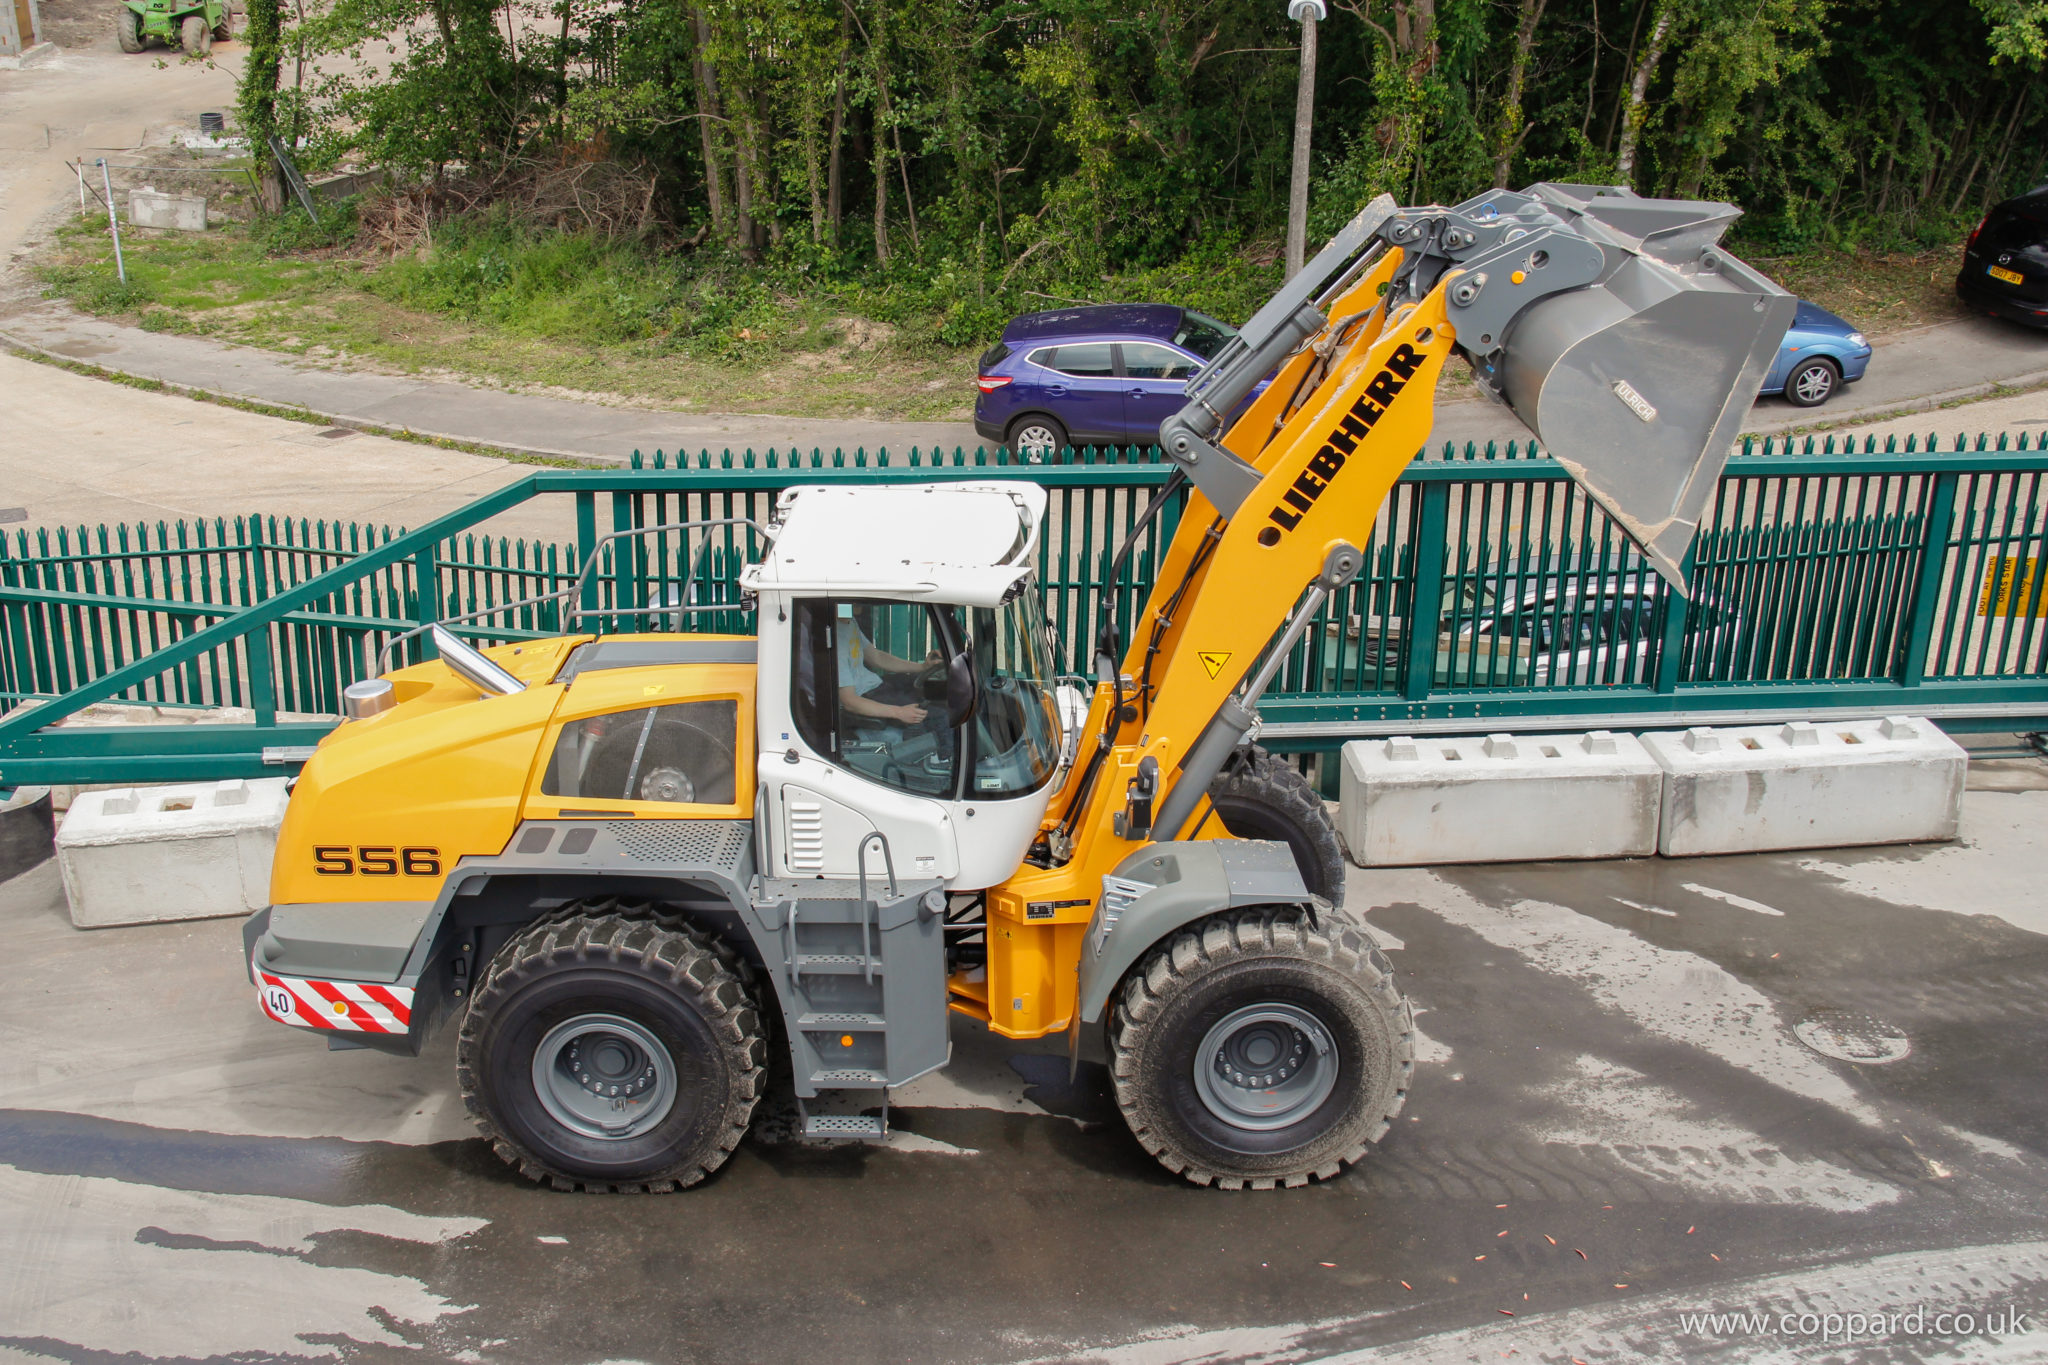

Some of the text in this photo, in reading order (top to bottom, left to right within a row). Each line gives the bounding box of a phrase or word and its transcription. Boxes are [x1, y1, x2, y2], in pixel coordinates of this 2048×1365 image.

[1618, 384, 1654, 419] ULRICH
[1268, 343, 1428, 533] LIEBHERR
[313, 845, 442, 877] 556
[270, 991, 289, 1013] 40
